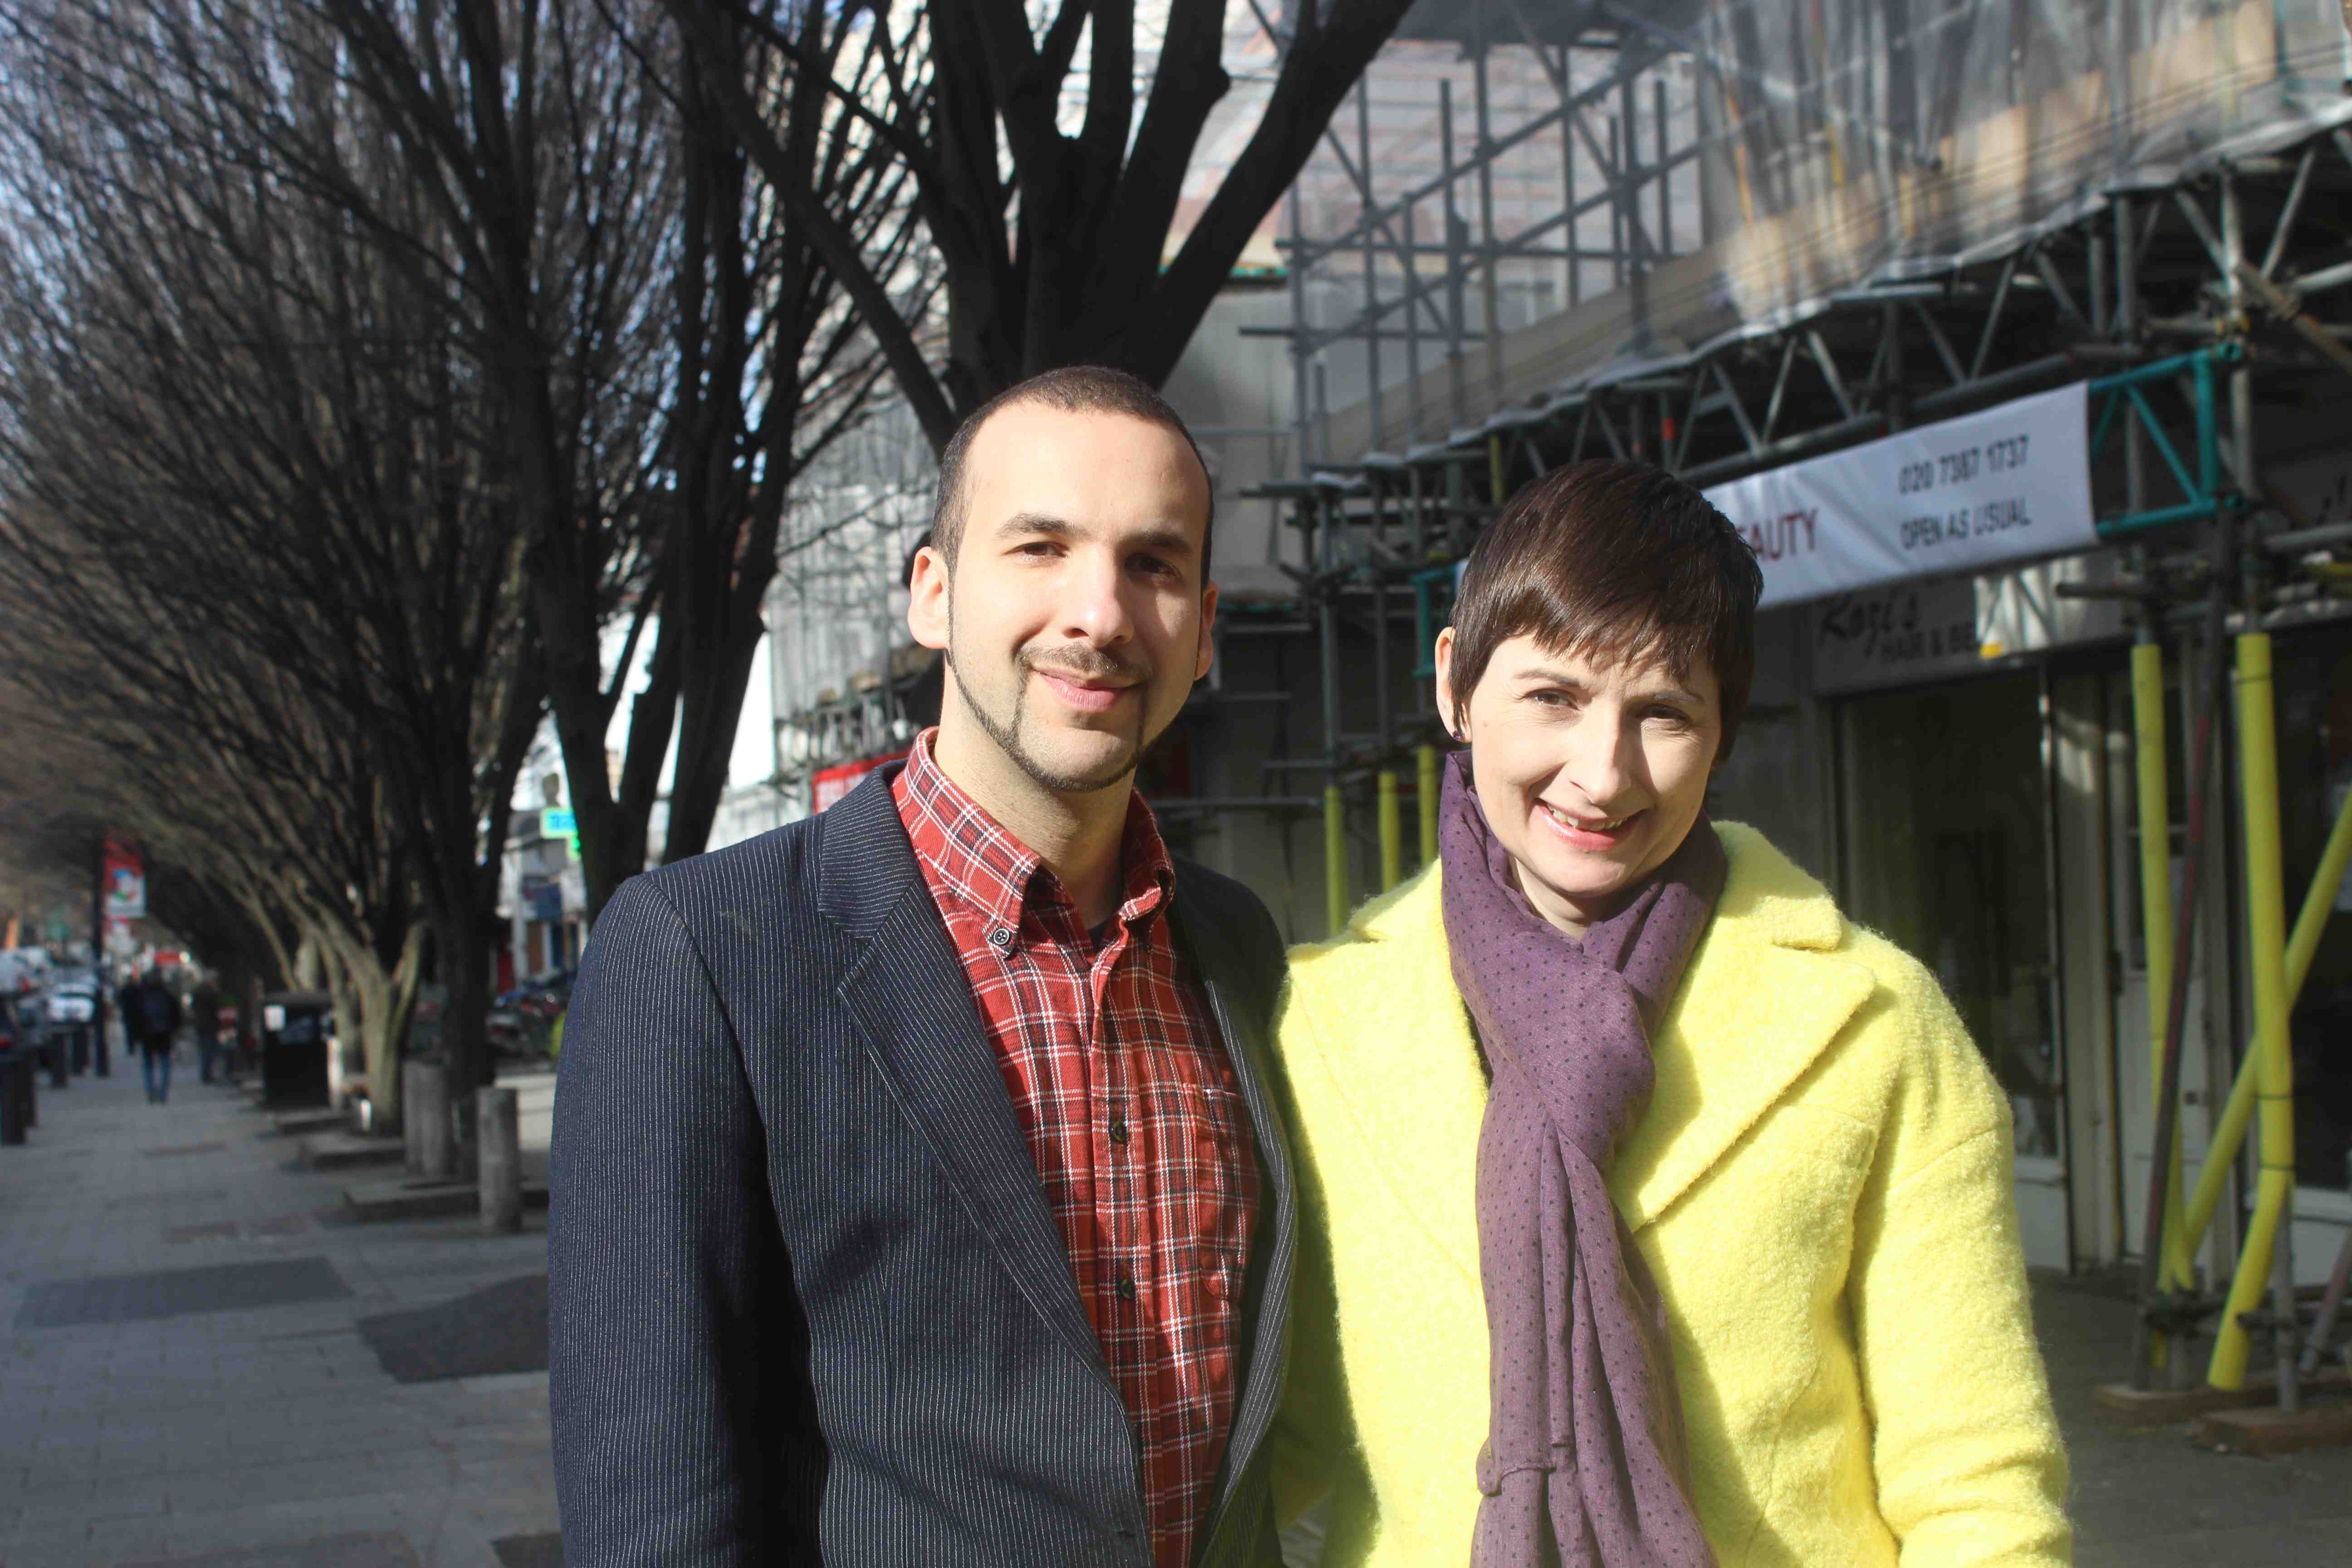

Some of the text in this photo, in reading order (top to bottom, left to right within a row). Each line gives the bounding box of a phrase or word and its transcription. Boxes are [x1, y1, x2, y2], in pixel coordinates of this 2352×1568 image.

[1899, 461, 1934, 495] 020
[1987, 434, 2029, 473] 1737
[1735, 507, 1818, 562] AUTY
[1901, 498, 2034, 550] OPEN AS USUAL
